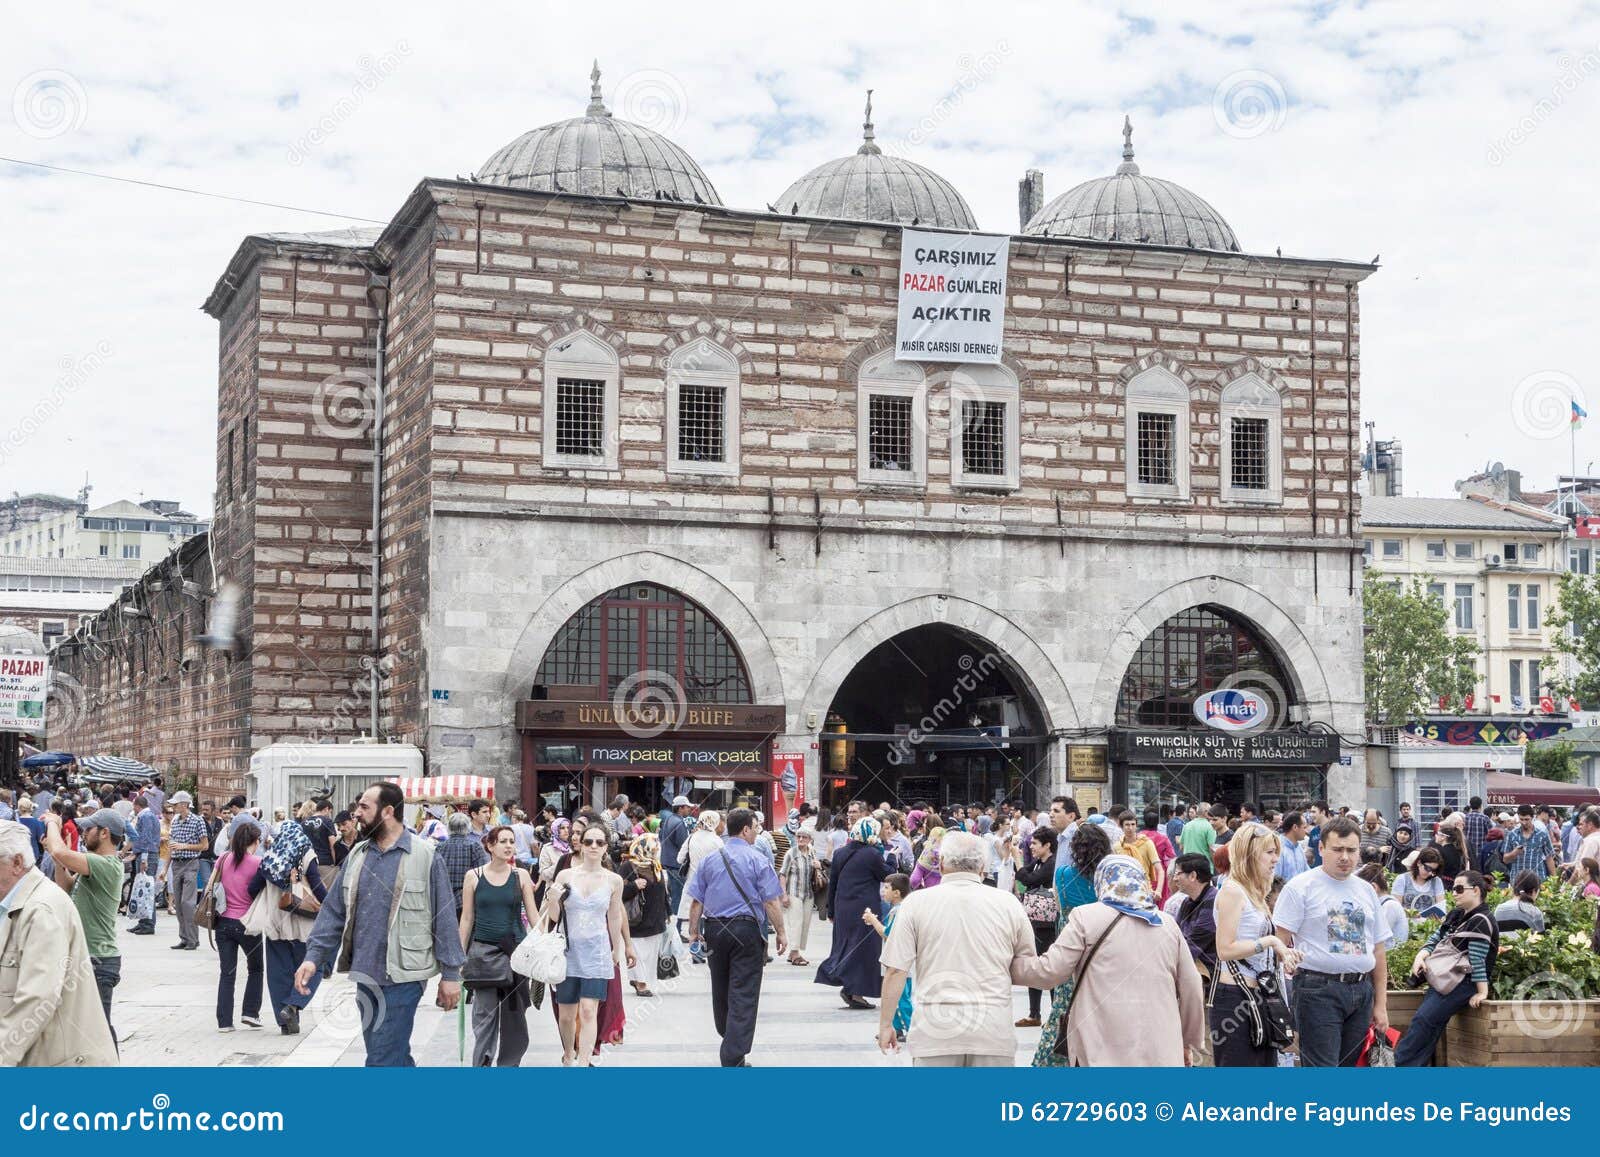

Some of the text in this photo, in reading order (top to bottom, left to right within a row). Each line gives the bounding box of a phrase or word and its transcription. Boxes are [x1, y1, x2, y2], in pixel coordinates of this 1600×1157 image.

[915, 248, 997, 267] ÇARŞIMIZ
[903, 273, 1002, 295] PAZAR GÜNLERİ
[912, 306, 992, 323] AÇIKTIR
[1, 659, 44, 676] PAZARI
[579, 705, 676, 725] ÜNLÜOĞLU
[689, 706, 734, 726] BÜFE
[1205, 735, 1226, 747] SÜT
[1232, 737, 1245, 747] VE
[1251, 735, 1272, 748] SÜT
[1277, 736, 1328, 748] ÜRÜNLERİ
[1163, 747, 1306, 760] FABRİKA SATIŞ MAĞAZASI
